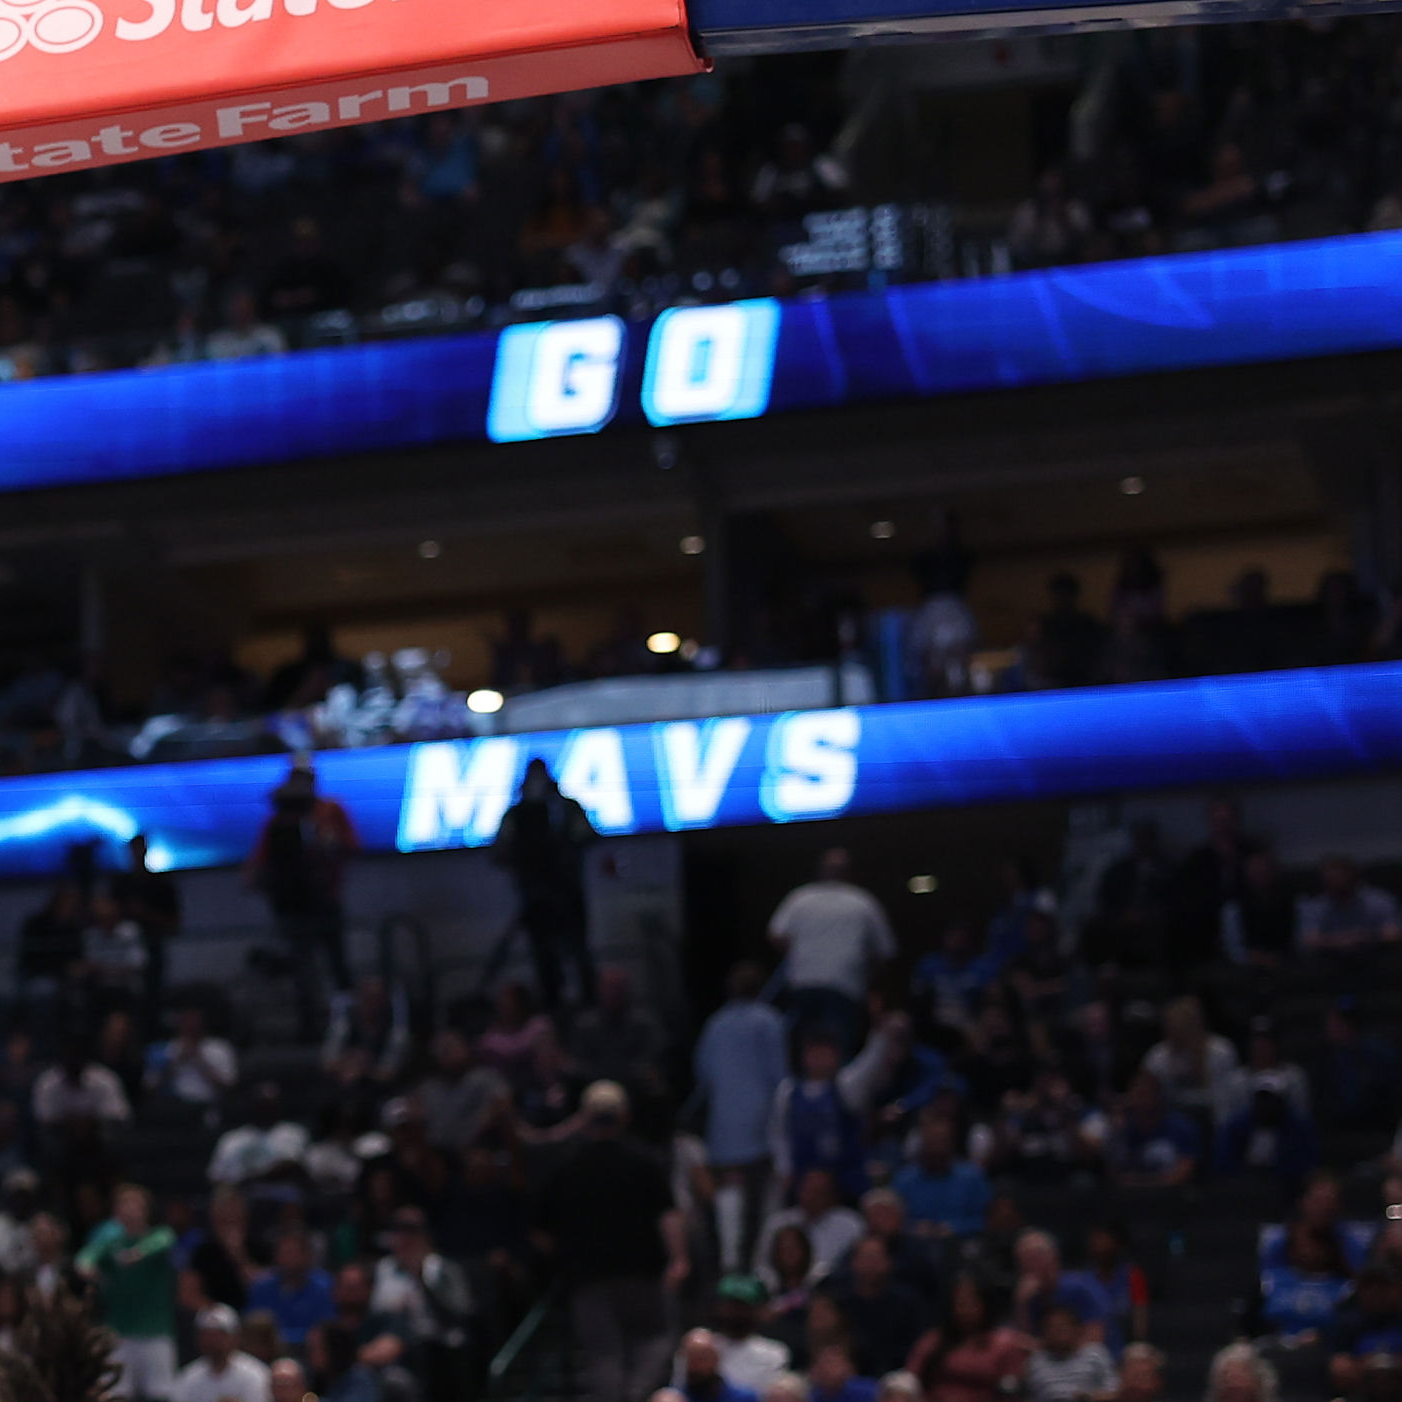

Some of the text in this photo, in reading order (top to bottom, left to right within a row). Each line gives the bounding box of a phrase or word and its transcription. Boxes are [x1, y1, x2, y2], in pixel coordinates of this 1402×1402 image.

[216, 75, 490, 140] Farm
[487, 297, 781, 444] GO
[397, 706, 862, 844] MAVS
